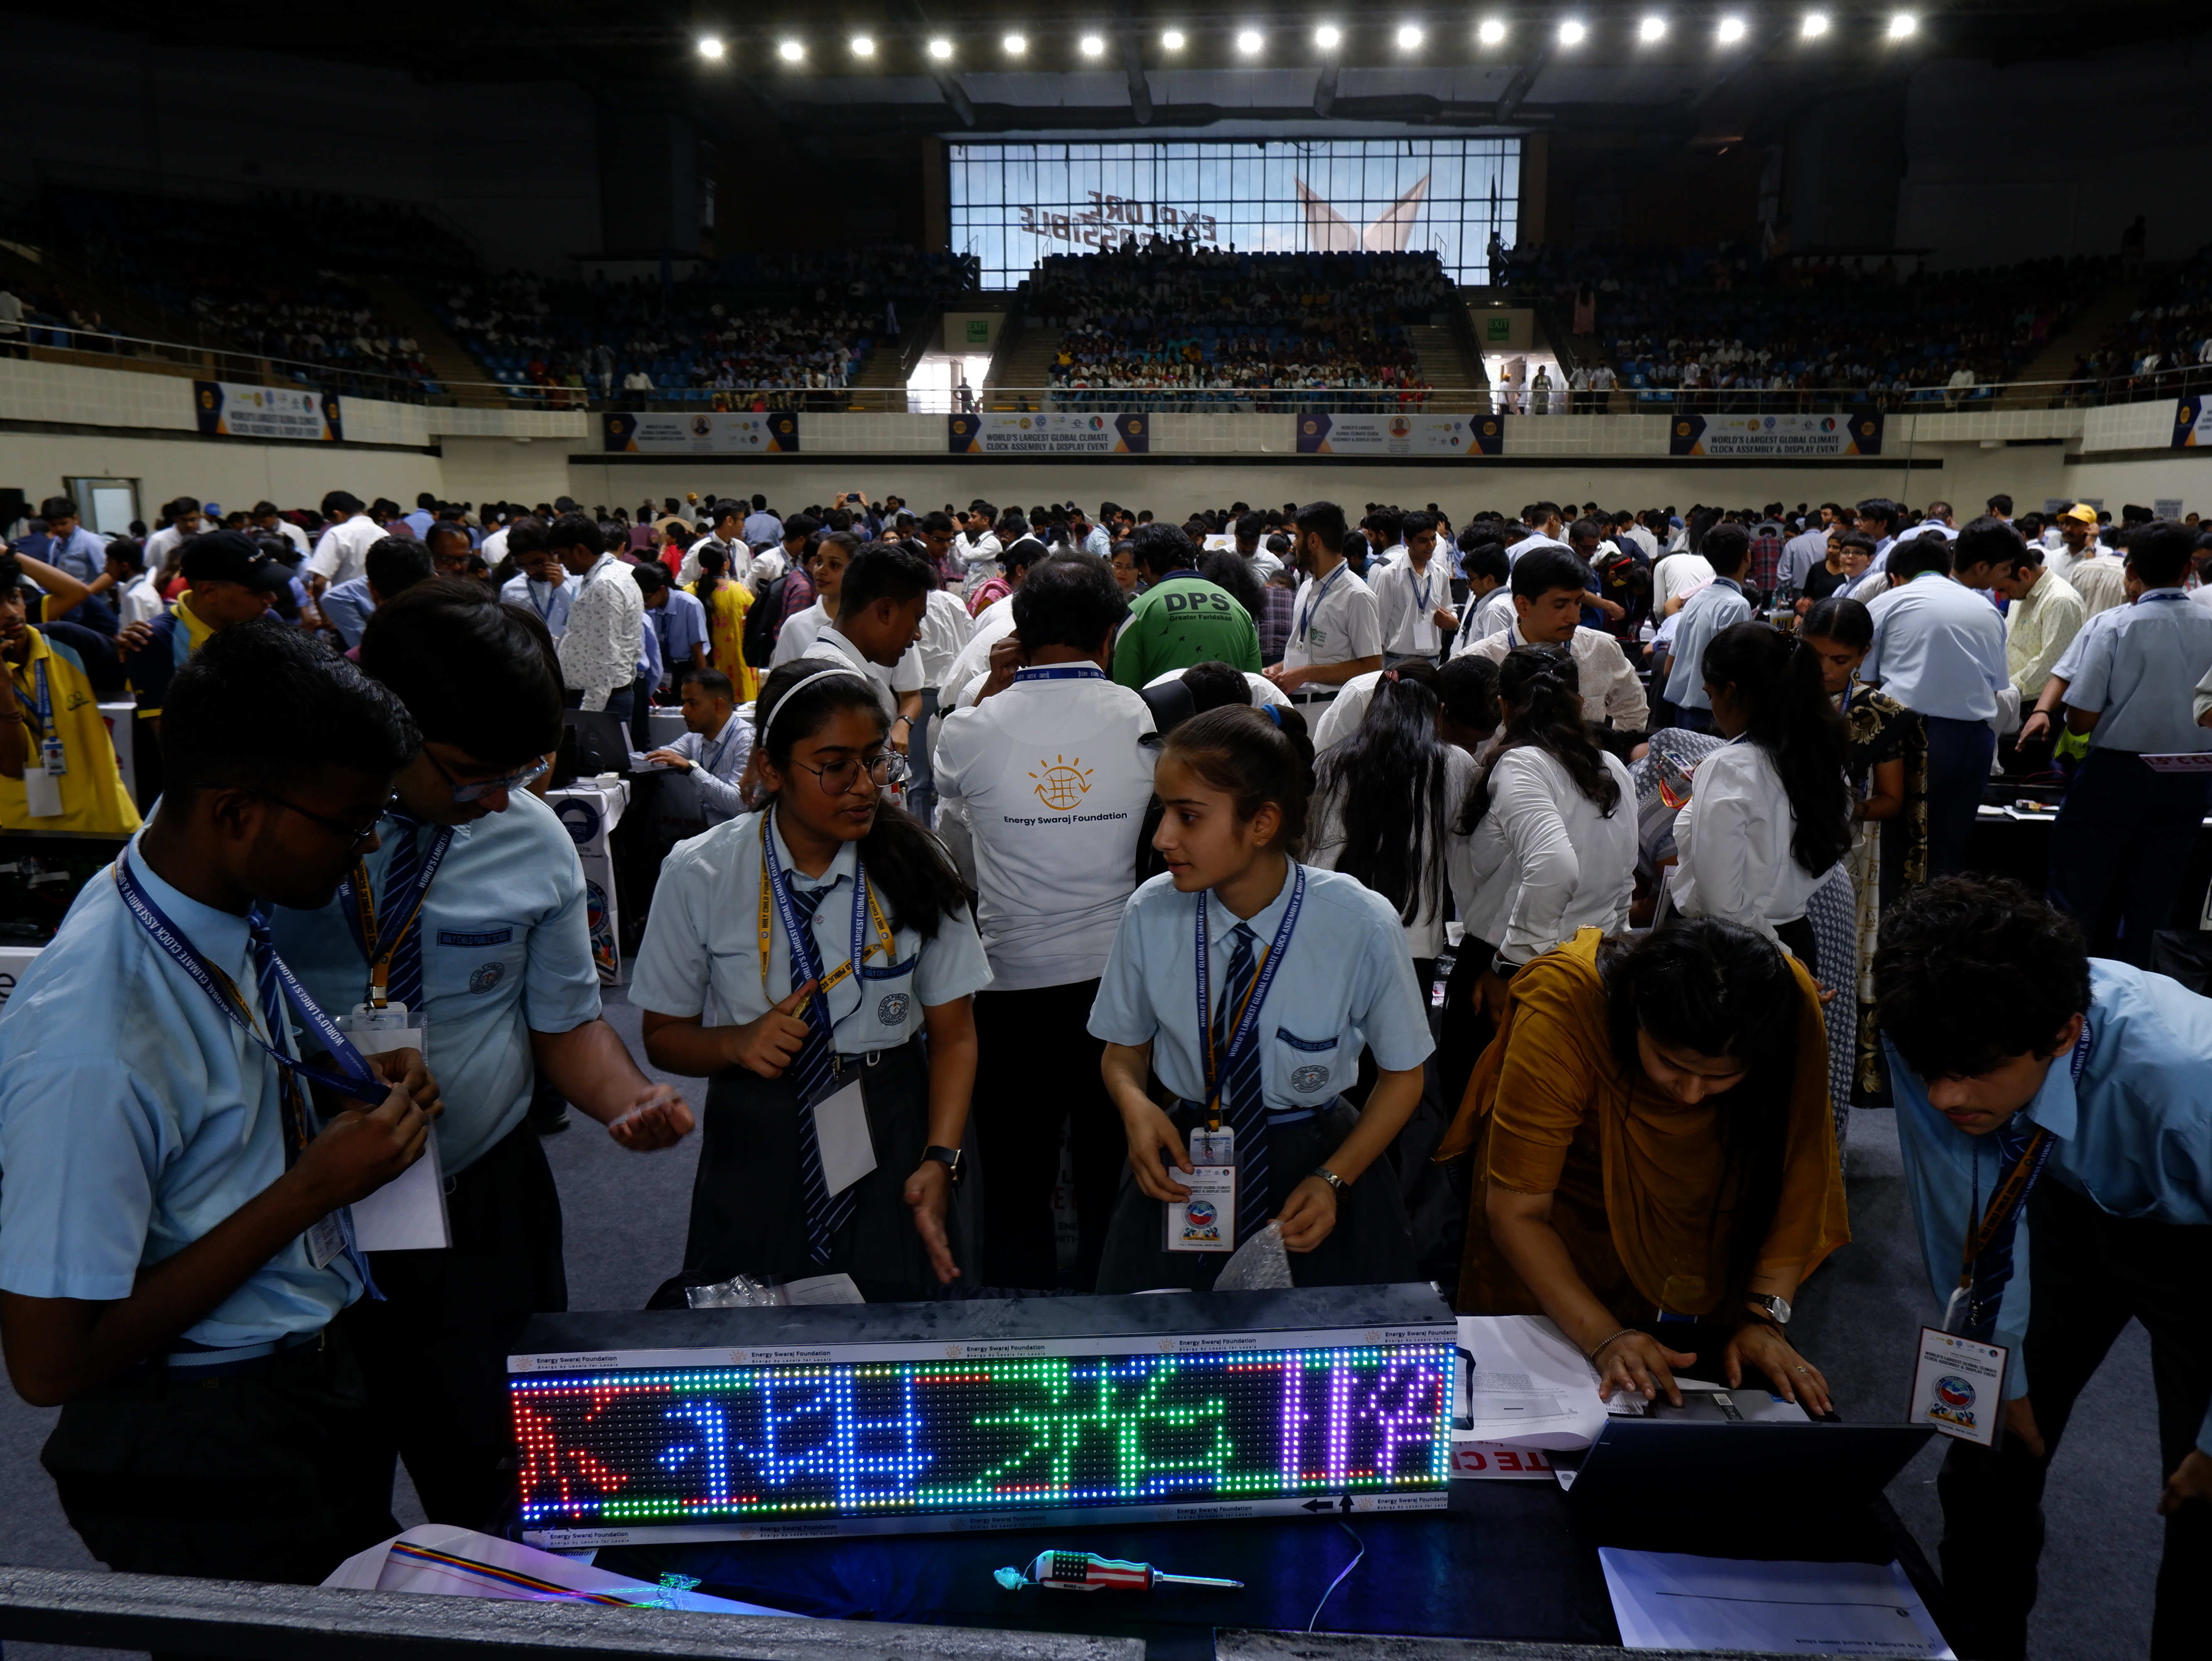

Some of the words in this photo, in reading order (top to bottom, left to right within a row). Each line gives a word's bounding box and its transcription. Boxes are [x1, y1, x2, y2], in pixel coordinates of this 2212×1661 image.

[1164, 593, 1231, 612] DPS
[1004, 816, 1036, 826] Energy
[1038, 815, 1072, 825] Swaraj
[1073, 812, 1128, 822] Foundation
[418, 860, 437, 889] WORLD'S
[432, 834, 449, 861] LARGEST
[769, 857, 778, 877] CLOCK
[121, 882, 130, 892] &
[773, 877, 787, 904] CLIMATE
[124, 890, 161, 930] ASSEMBLY
[361, 889, 372, 914] PUBLIC
[856, 894, 865, 919] GLOBAL
[365, 914, 373, 936] CHILD
[781, 904, 795, 930] GLOBAL
[874, 916, 885, 930] HOLY
[154, 926, 182, 953] CLOCK
[443, 933, 456, 943] HOLY
[457, 935, 473, 943] CHILD
[474, 934, 492, 943] PUBLIC
[789, 927, 803, 956] LARGEST
[854, 919, 864, 945] LARGEST
[177, 951, 210, 984] CLIMATE
[274, 955, 297, 983] GLOBAL
[853, 946, 861, 975] WORLD'S
[830, 968, 846, 983] PUBLIC
[1228, 1030, 1246, 1057] WORLD'S
[1242, 1007, 1257, 1034] LARGEST
[1252, 981, 1267, 1005] GLOBAL
[1262, 955, 1278, 982] CLIMATE
[1273, 931, 1288, 955] CLOCK
[1282, 900, 1299, 935] ASSEMBLY
[207, 983, 229, 1012] GLOBAL
[290, 980, 321, 1017] LARGEST
[315, 1013, 346, 1046] WORLD'S
[2011, 1196, 2026, 1222] WORLD'S
[2038, 1142, 2054, 1165] GLOBAL
[1980, 1227, 1991, 1240] HOLY
[1988, 1210, 2000, 1229] CHILD
[1999, 1195, 2011, 1214] PUBLIC
[1925, 1351, 1943, 1359] WORLD'S
[1963, 1360, 1979, 1369] GLOBAL
[1939, 1359, 1960, 1368] ASSEMBLY
